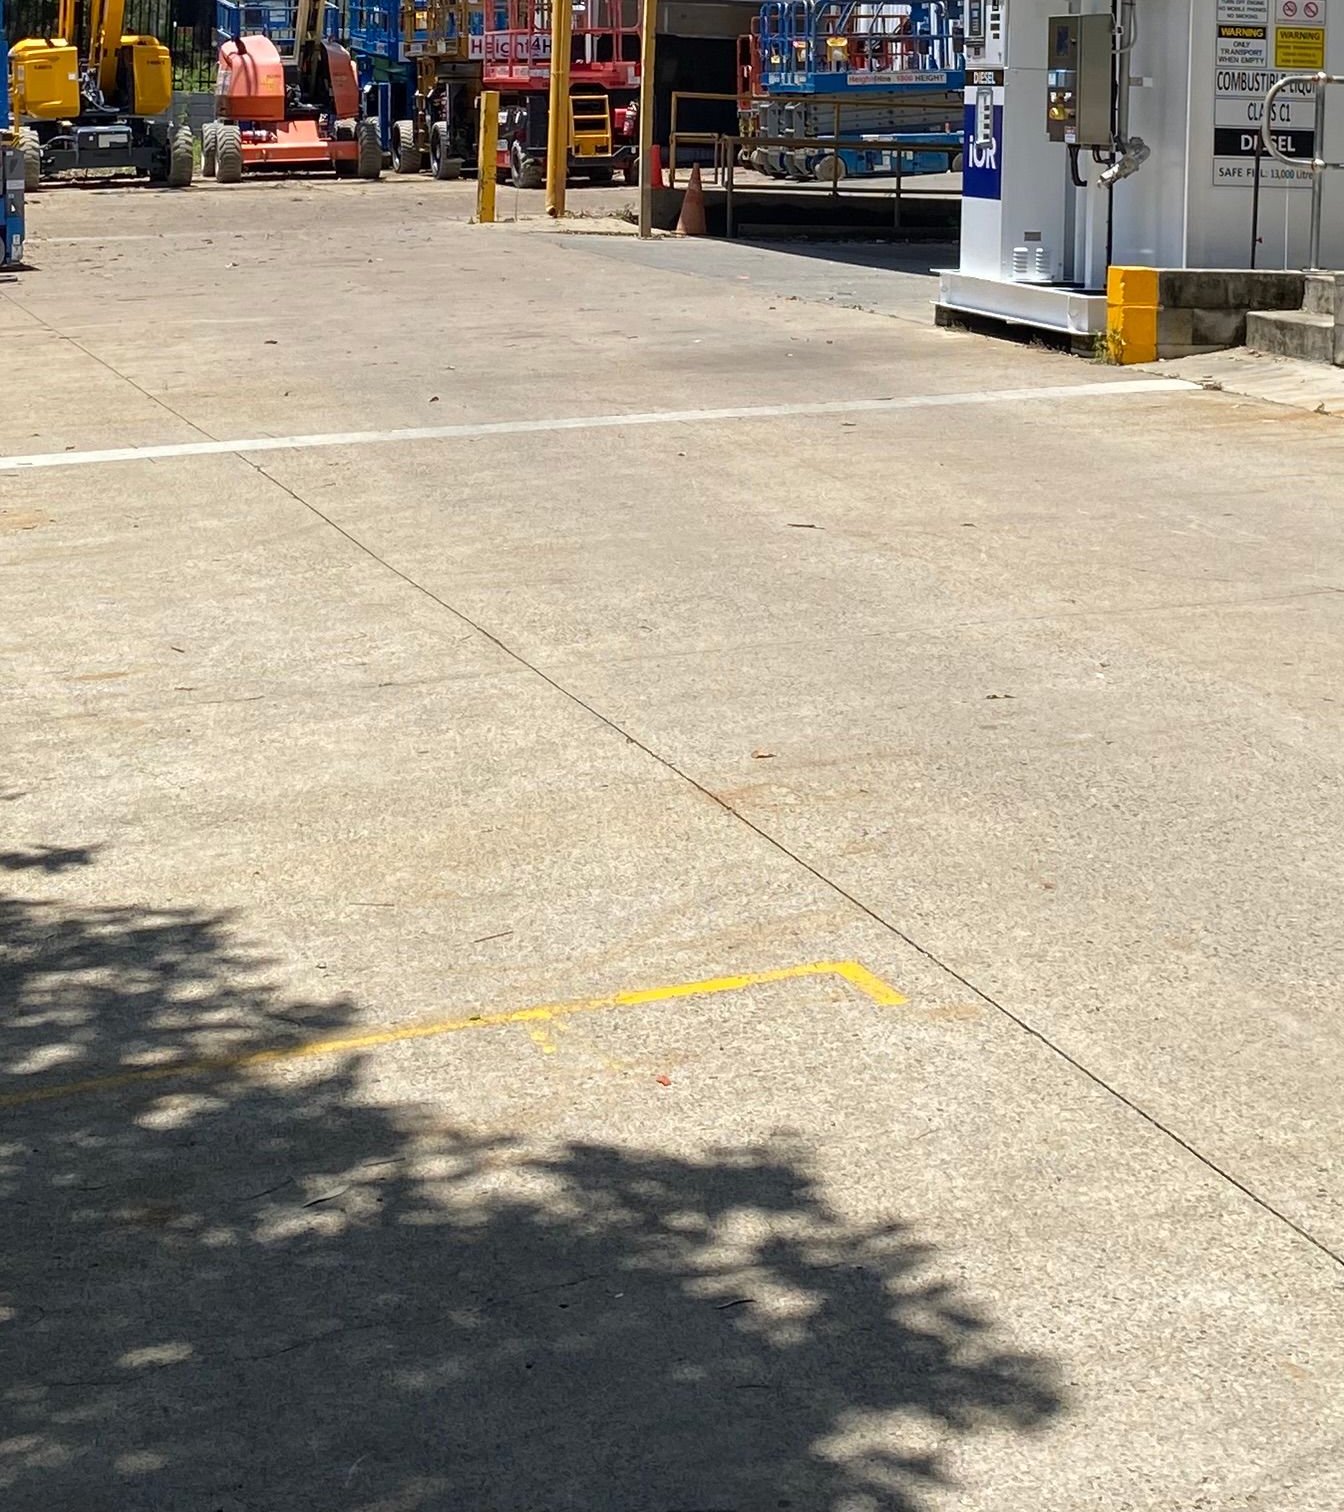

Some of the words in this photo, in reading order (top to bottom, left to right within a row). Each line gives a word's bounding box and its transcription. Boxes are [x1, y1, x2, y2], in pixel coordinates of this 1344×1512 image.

[1220, 27, 1264, 37] WARNING
[1279, 31, 1321, 41] WARNING
[1232, 40, 1251, 48] ONLY
[1220, 48, 1263, 56] TRANSPORT
[1218, 56, 1240, 64] WHEN
[1240, 57, 1264, 65] EMPTY
[914, 74, 945, 82] HEIGHT
[973, 71, 996, 84] DIESEL
[1247, 102, 1277, 122] CLAS
[1279, 103, 1292, 122] C1
[1240, 134, 1296, 152] DISEL
[1218, 167, 1243, 178] SAFE
[1270, 169, 1295, 181] 13,000
